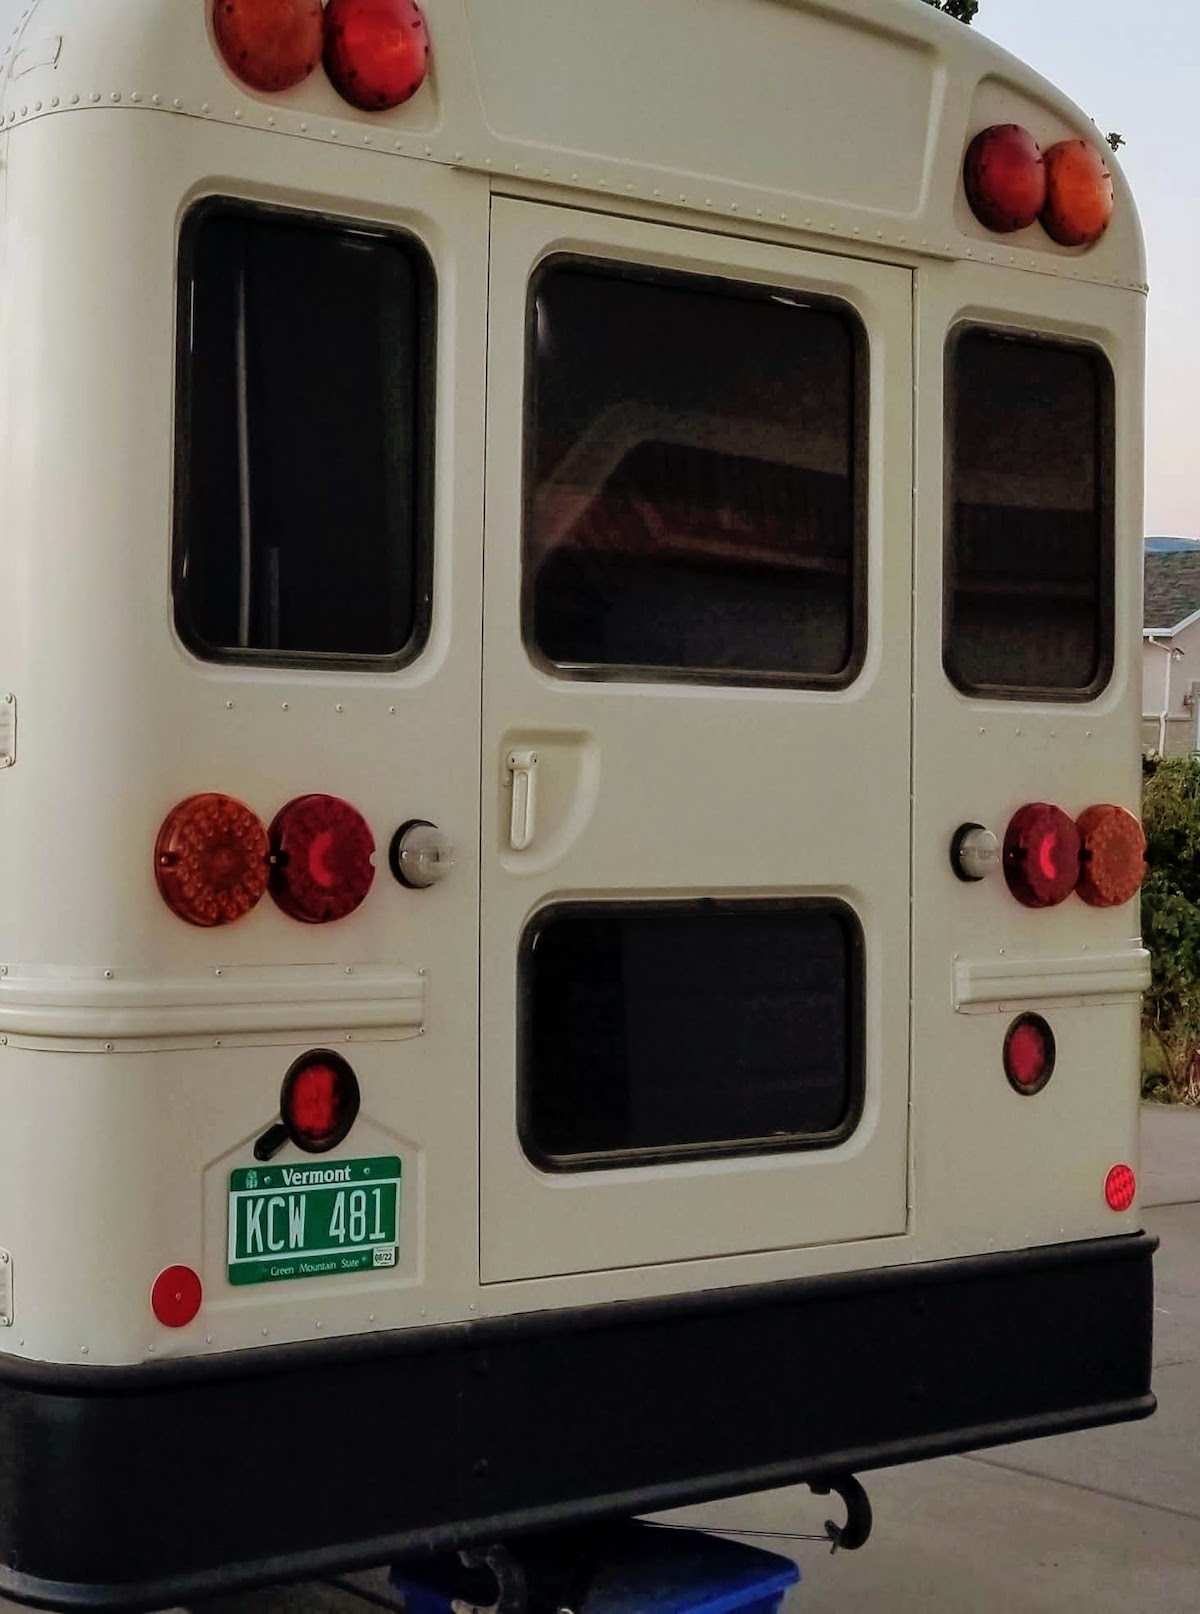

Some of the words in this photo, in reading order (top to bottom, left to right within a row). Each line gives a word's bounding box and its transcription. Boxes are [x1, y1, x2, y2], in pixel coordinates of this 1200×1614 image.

[281, 1165, 351, 1186] Vermont
[246, 1194, 307, 1253] KCW
[329, 1188, 386, 1243] 481
[270, 1266, 295, 1276] Green
[300, 1262, 337, 1273] Mountain
[341, 1258, 360, 1269] State
